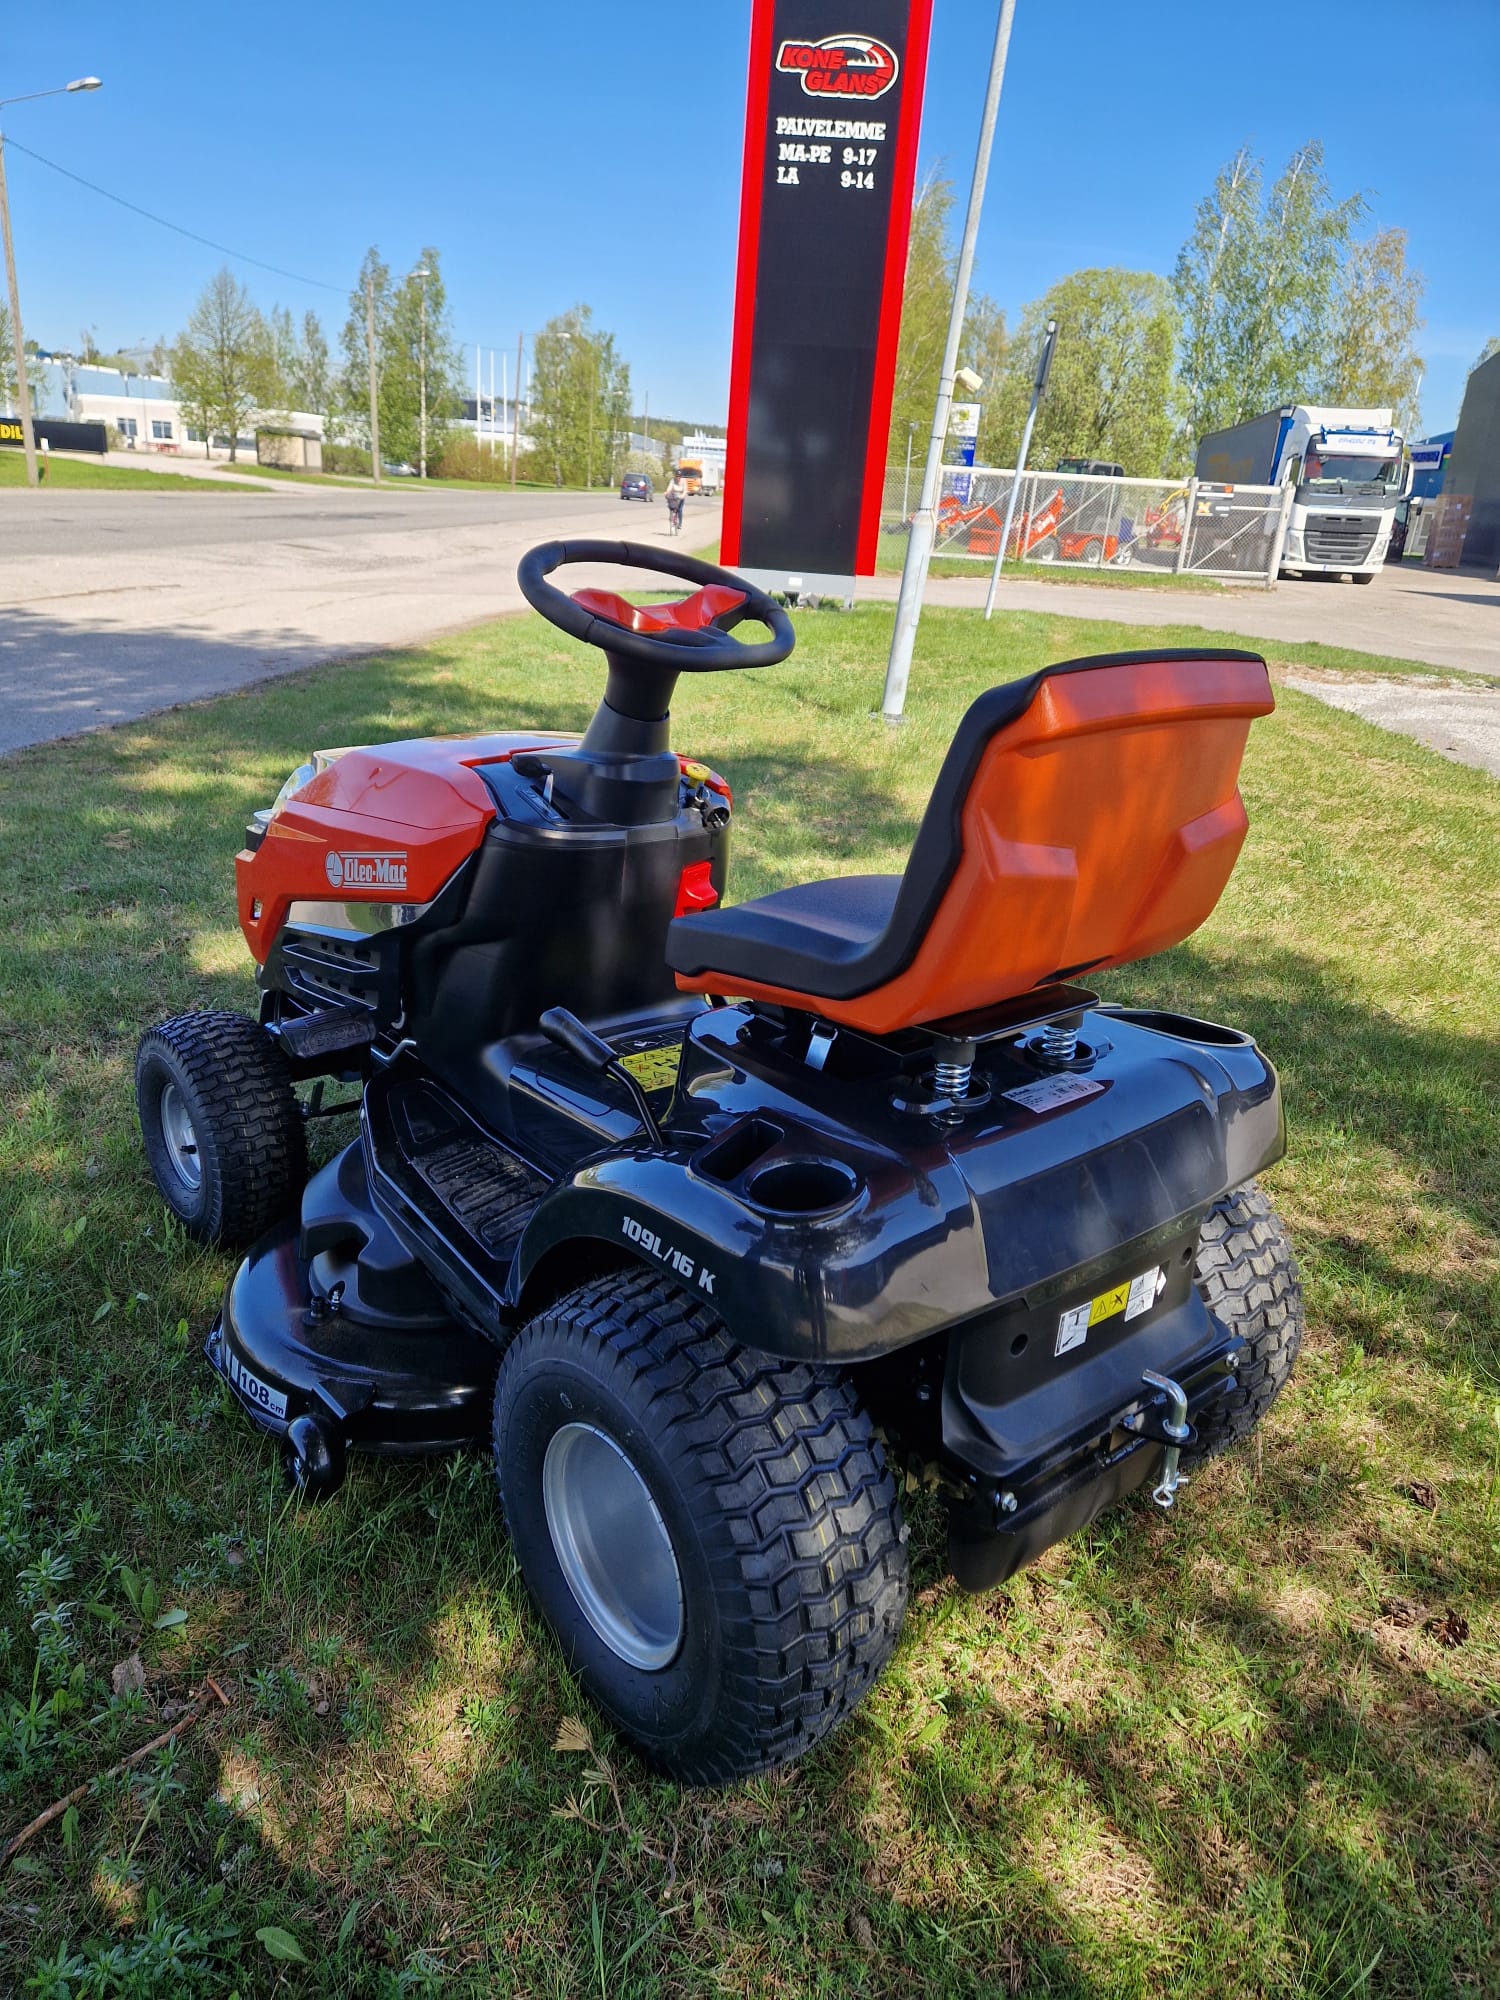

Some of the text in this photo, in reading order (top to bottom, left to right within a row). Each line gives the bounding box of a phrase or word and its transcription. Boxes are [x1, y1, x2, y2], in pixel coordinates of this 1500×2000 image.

[804, 71, 880, 94] GLANS
[776, 117, 886, 140] PALVELEMME
[778, 144, 877, 166] MA-PE 9-17
[777, 167, 874, 189] LA 9-14
[344, 858, 407, 883] Oleo-Mac
[621, 1215, 717, 1295] 109L/16 K
[240, 1372, 285, 1415] 108 cm
